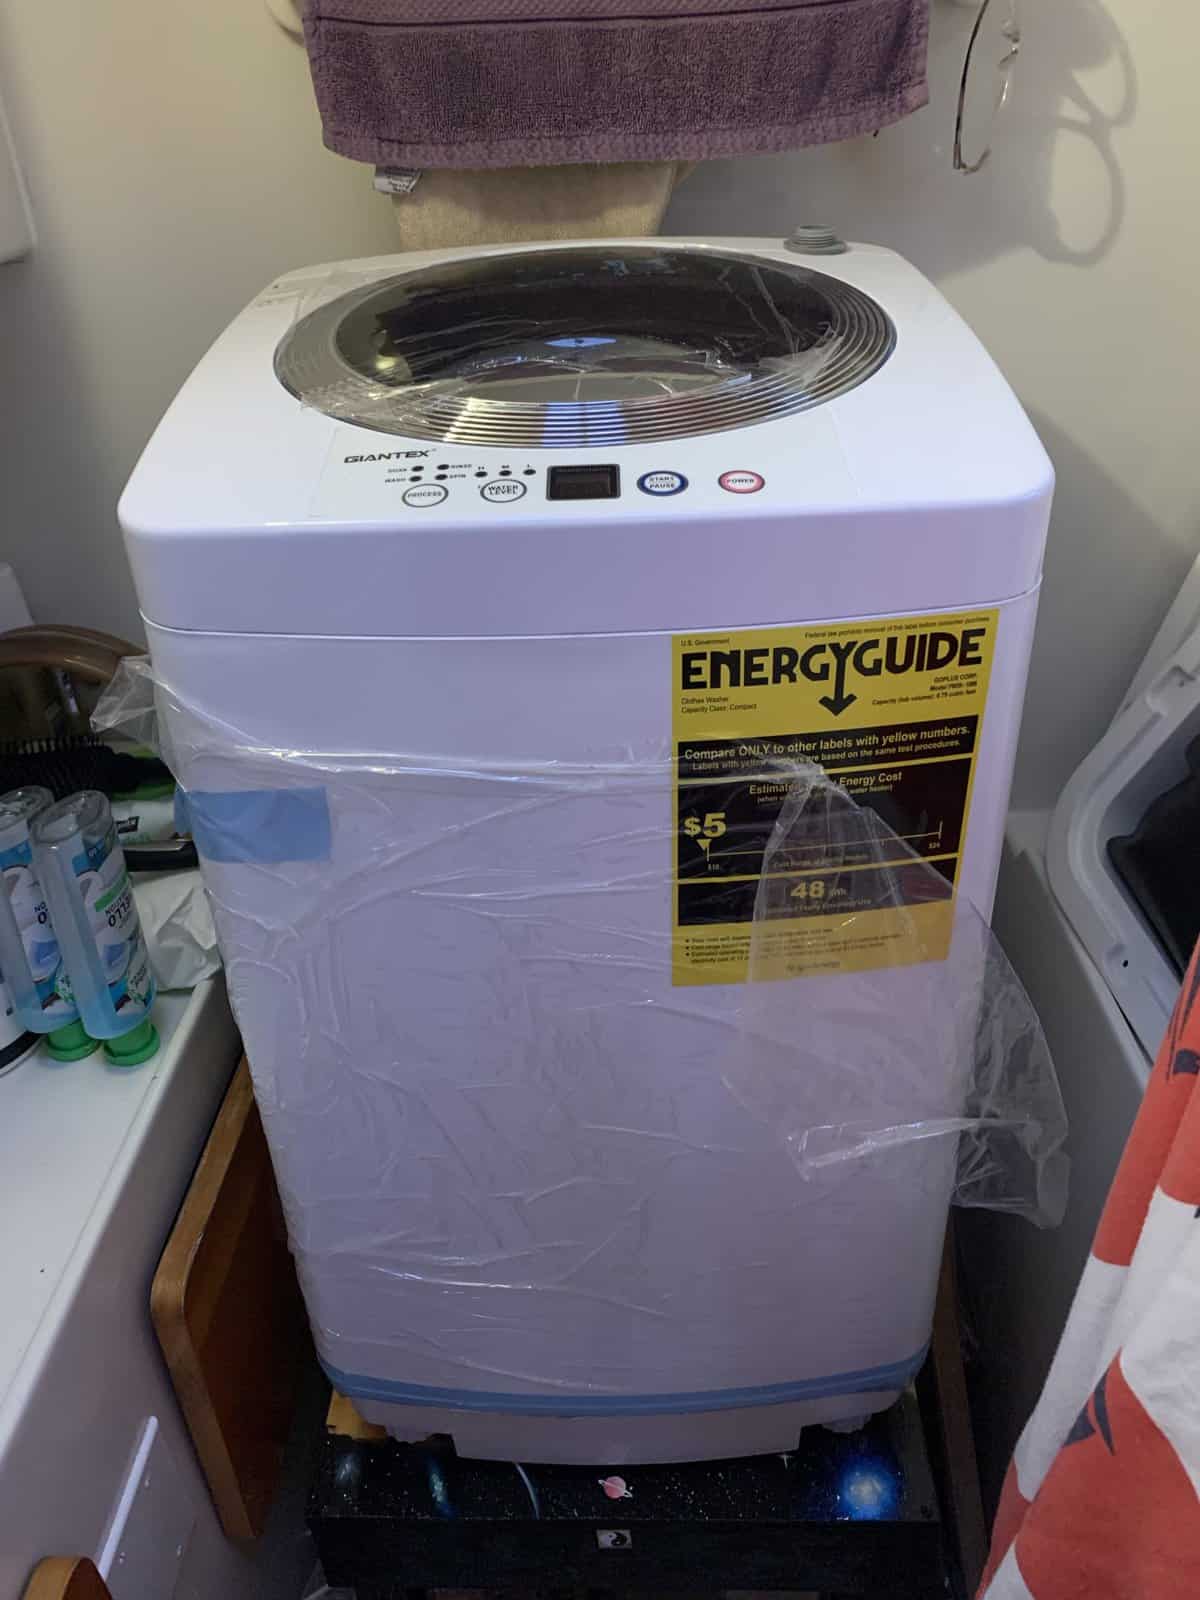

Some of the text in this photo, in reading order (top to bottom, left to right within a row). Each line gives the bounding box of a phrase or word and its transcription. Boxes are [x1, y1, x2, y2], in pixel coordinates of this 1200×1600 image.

[344, 449, 430, 463] GIANTEX
[727, 477, 756, 485] POWER
[407, 490, 443, 499] PROCESS
[695, 637, 731, 646] Government
[682, 628, 987, 695] ENERGYGUIDE
[681, 696, 729, 705] Clothes Washer
[681, 705, 708, 713] Capacity
[729, 702, 758, 711] Compact
[684, 725, 971, 762] Compare ONLY to other labels with yellow numbers.
[821, 751, 846, 761] based
[860, 748, 873, 757] the
[875, 746, 897, 756] same
[898, 744, 914, 753] test
[839, 774, 876, 787] Energy
[878, 771, 902, 783] Cost
[684, 811, 727, 838] $5
[790, 879, 826, 898] 48
